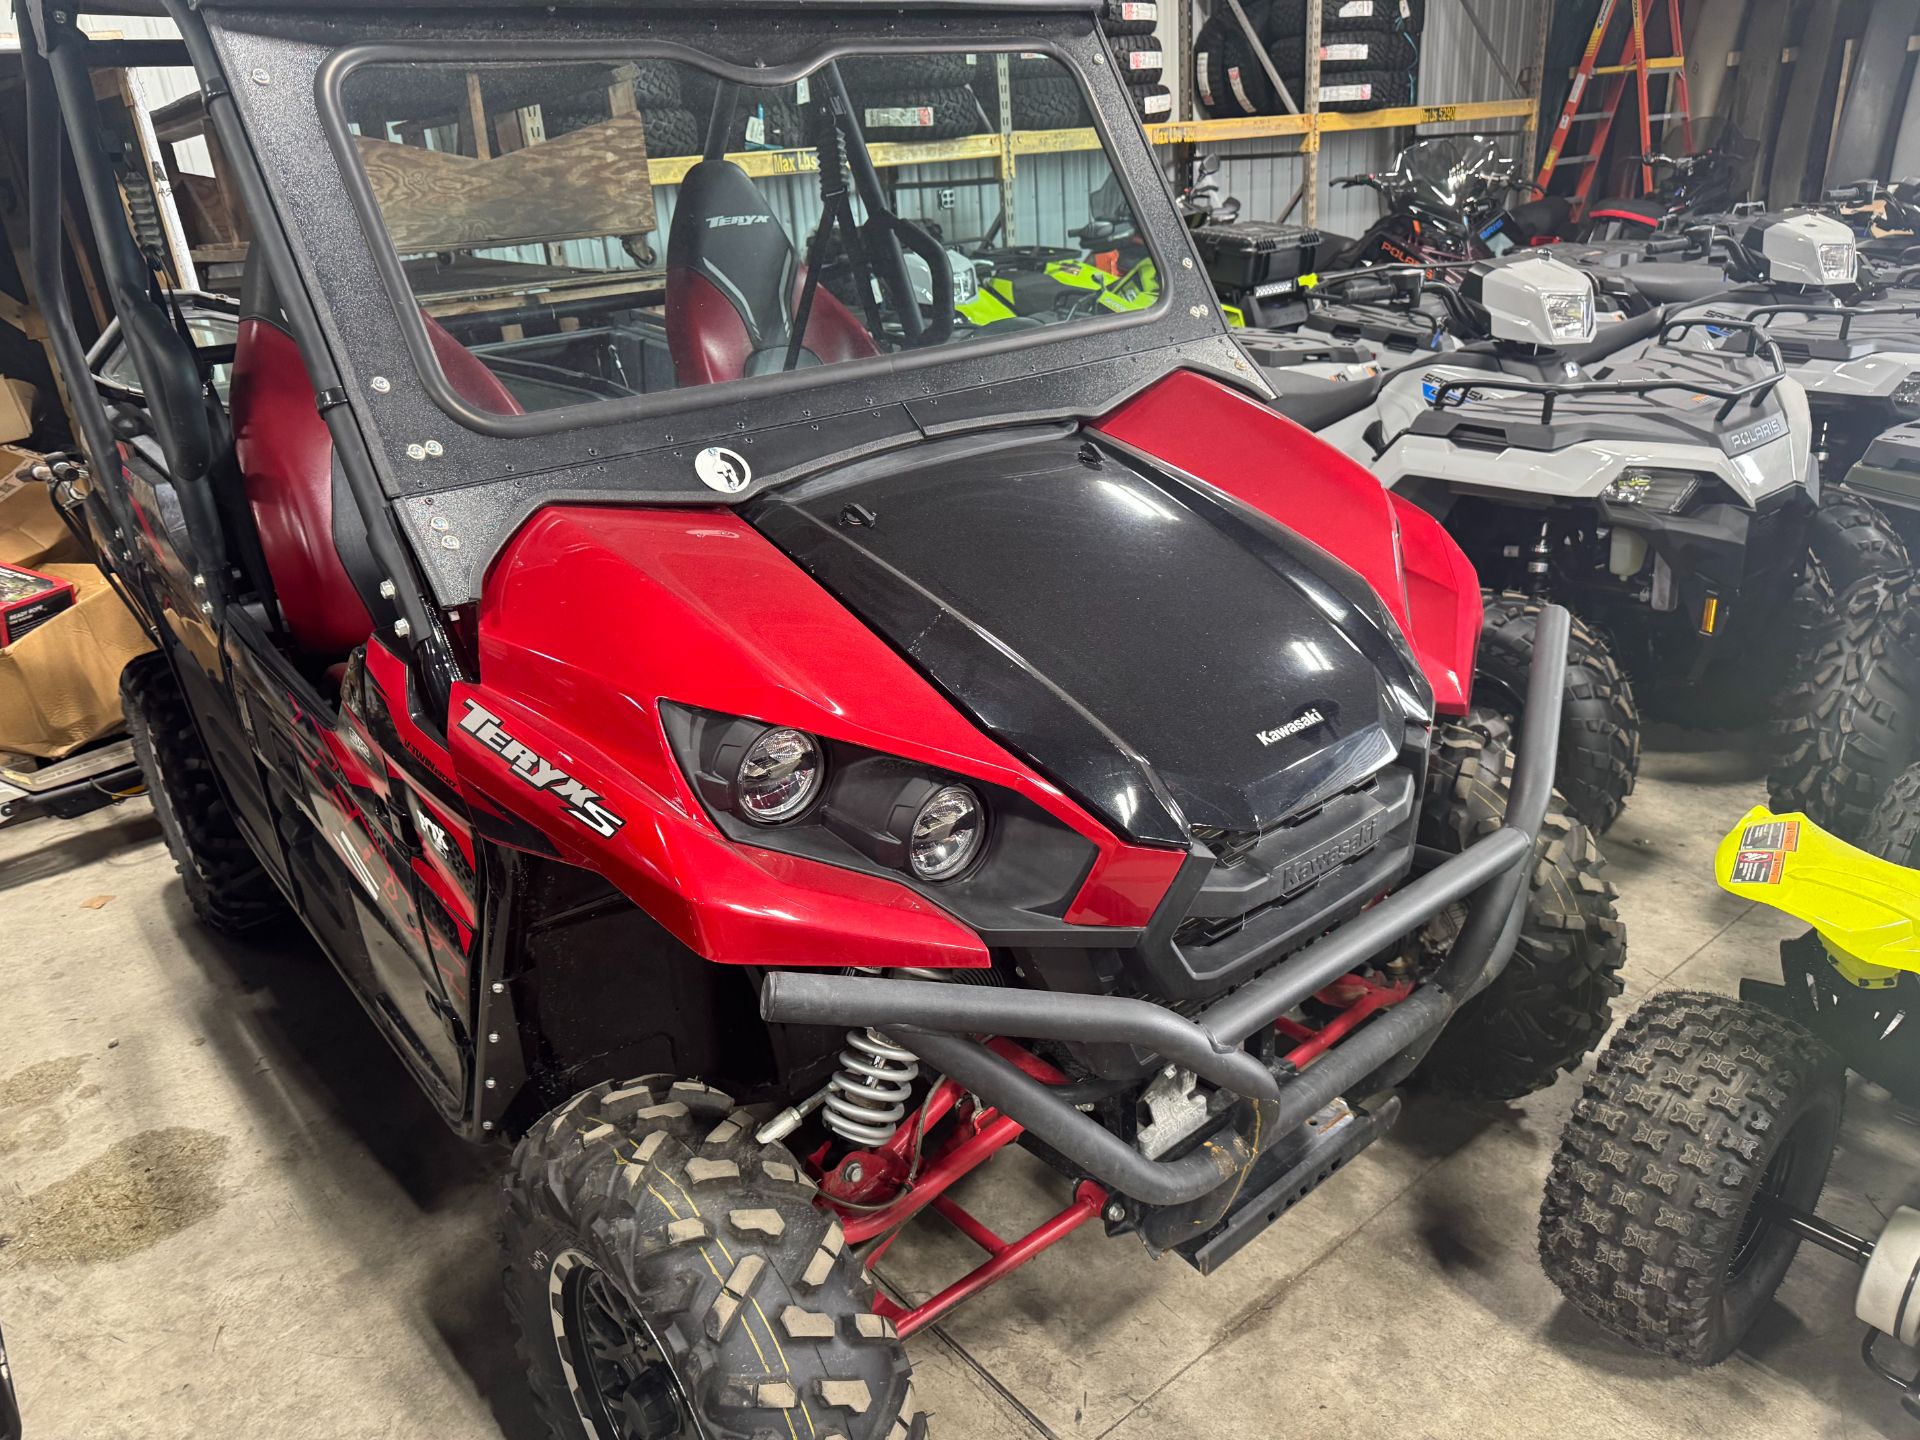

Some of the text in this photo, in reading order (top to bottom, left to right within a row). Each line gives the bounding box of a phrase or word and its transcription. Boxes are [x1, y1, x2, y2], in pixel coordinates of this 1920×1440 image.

[774, 150, 818, 173] Max Lbs
[1731, 419, 1781, 449] POLARIS
[1256, 708, 1325, 747] Kawasaki
[1282, 817, 1378, 890] Kawasaki
